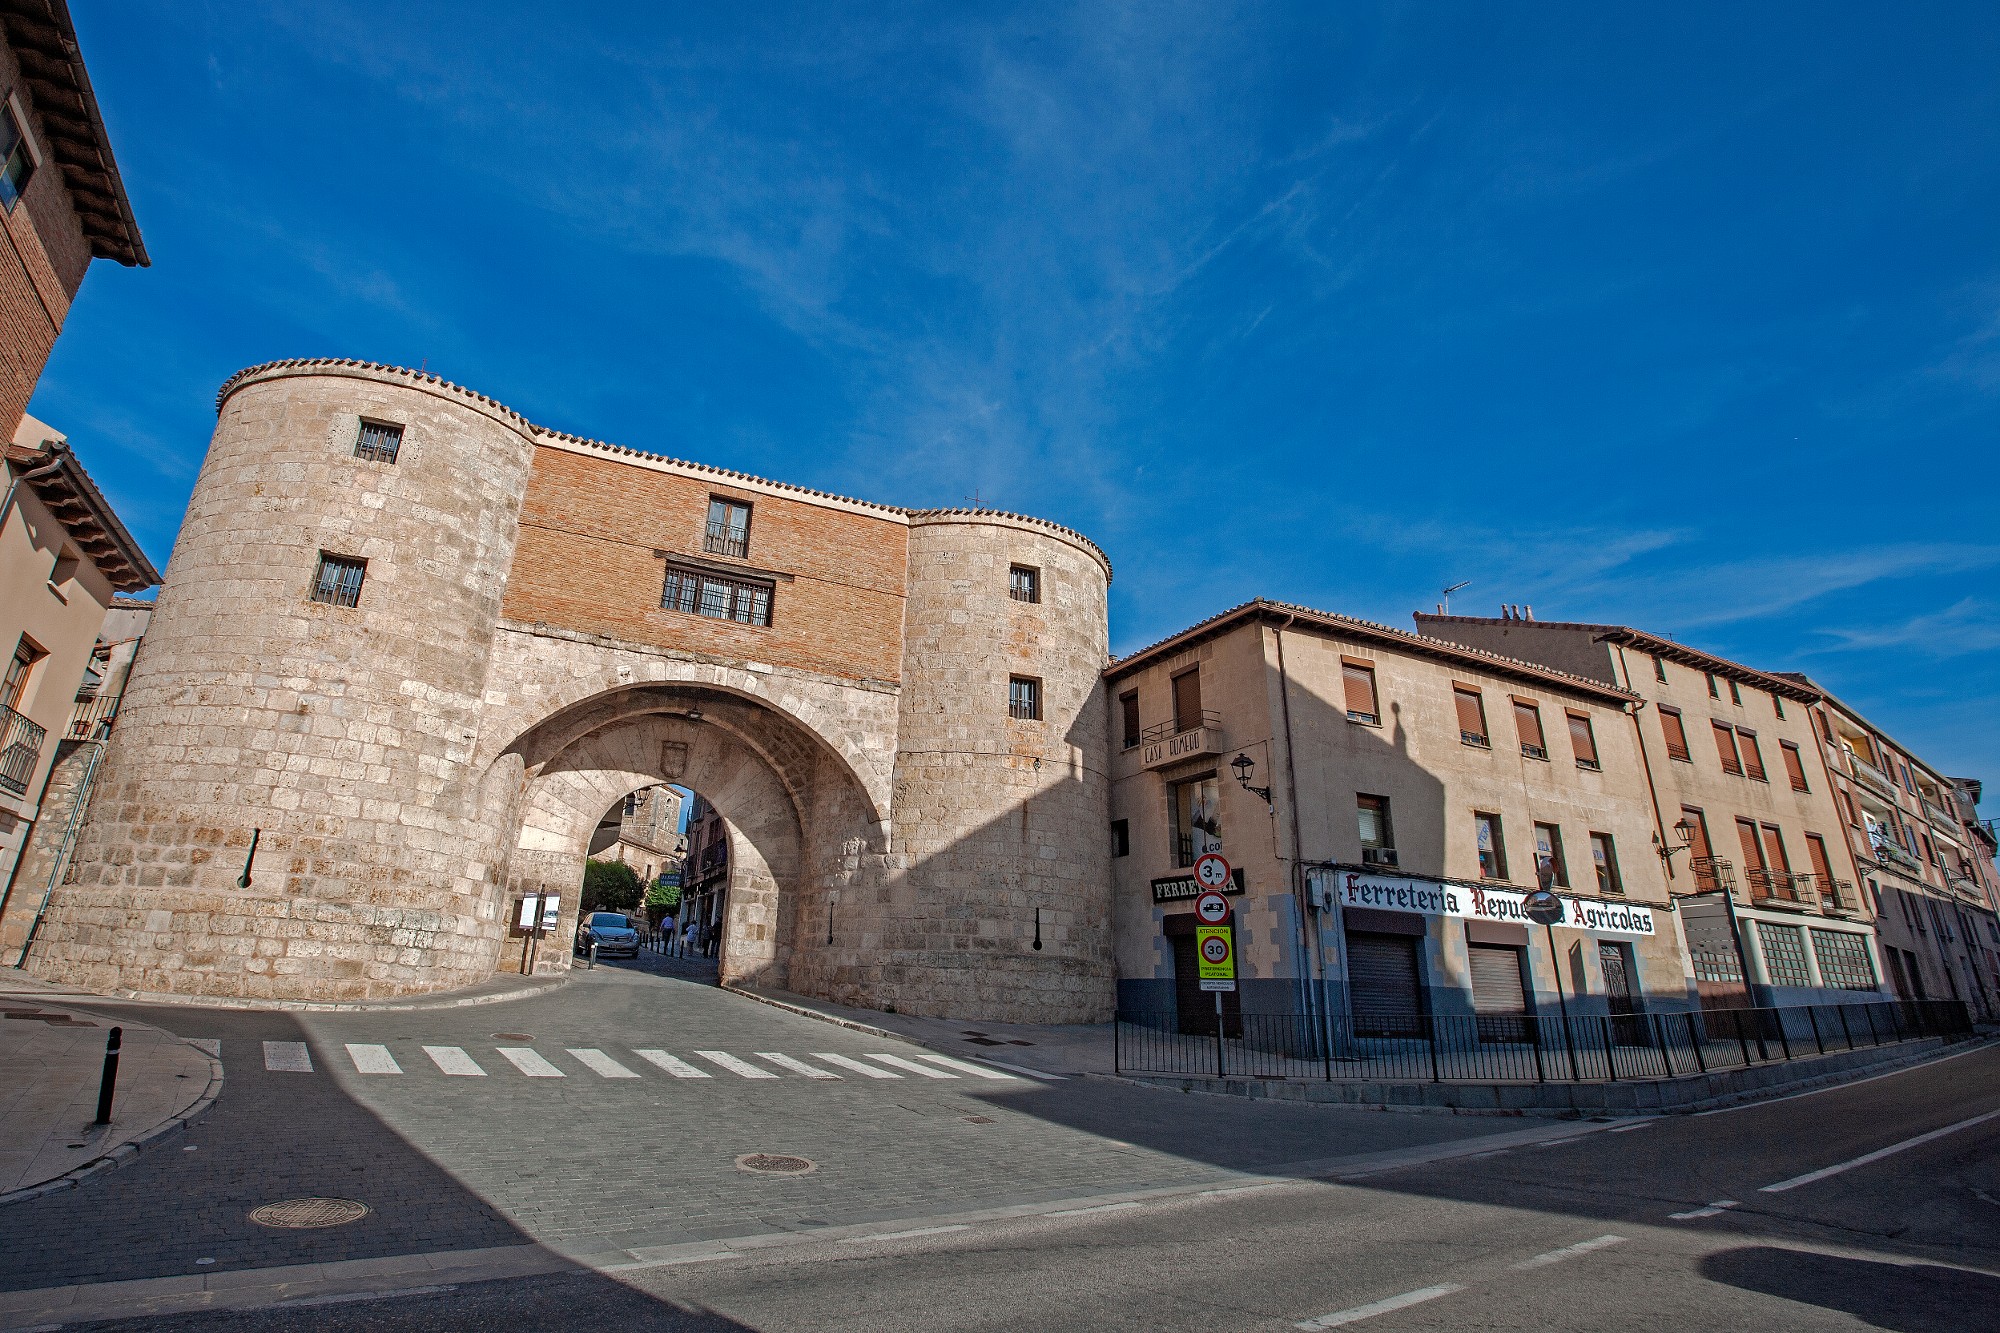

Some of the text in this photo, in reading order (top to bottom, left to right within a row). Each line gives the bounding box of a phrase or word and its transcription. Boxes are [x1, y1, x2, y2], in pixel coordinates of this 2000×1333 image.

[1145, 732, 1199, 763] CASA ROMERO
[1203, 865, 1213, 878] 3
[1155, 875, 1238, 899] FERRETIA
[1345, 873, 1460, 913] Ferreteria
[1470, 887, 1566, 924] Repue
[1207, 945, 1223, 955] 30
